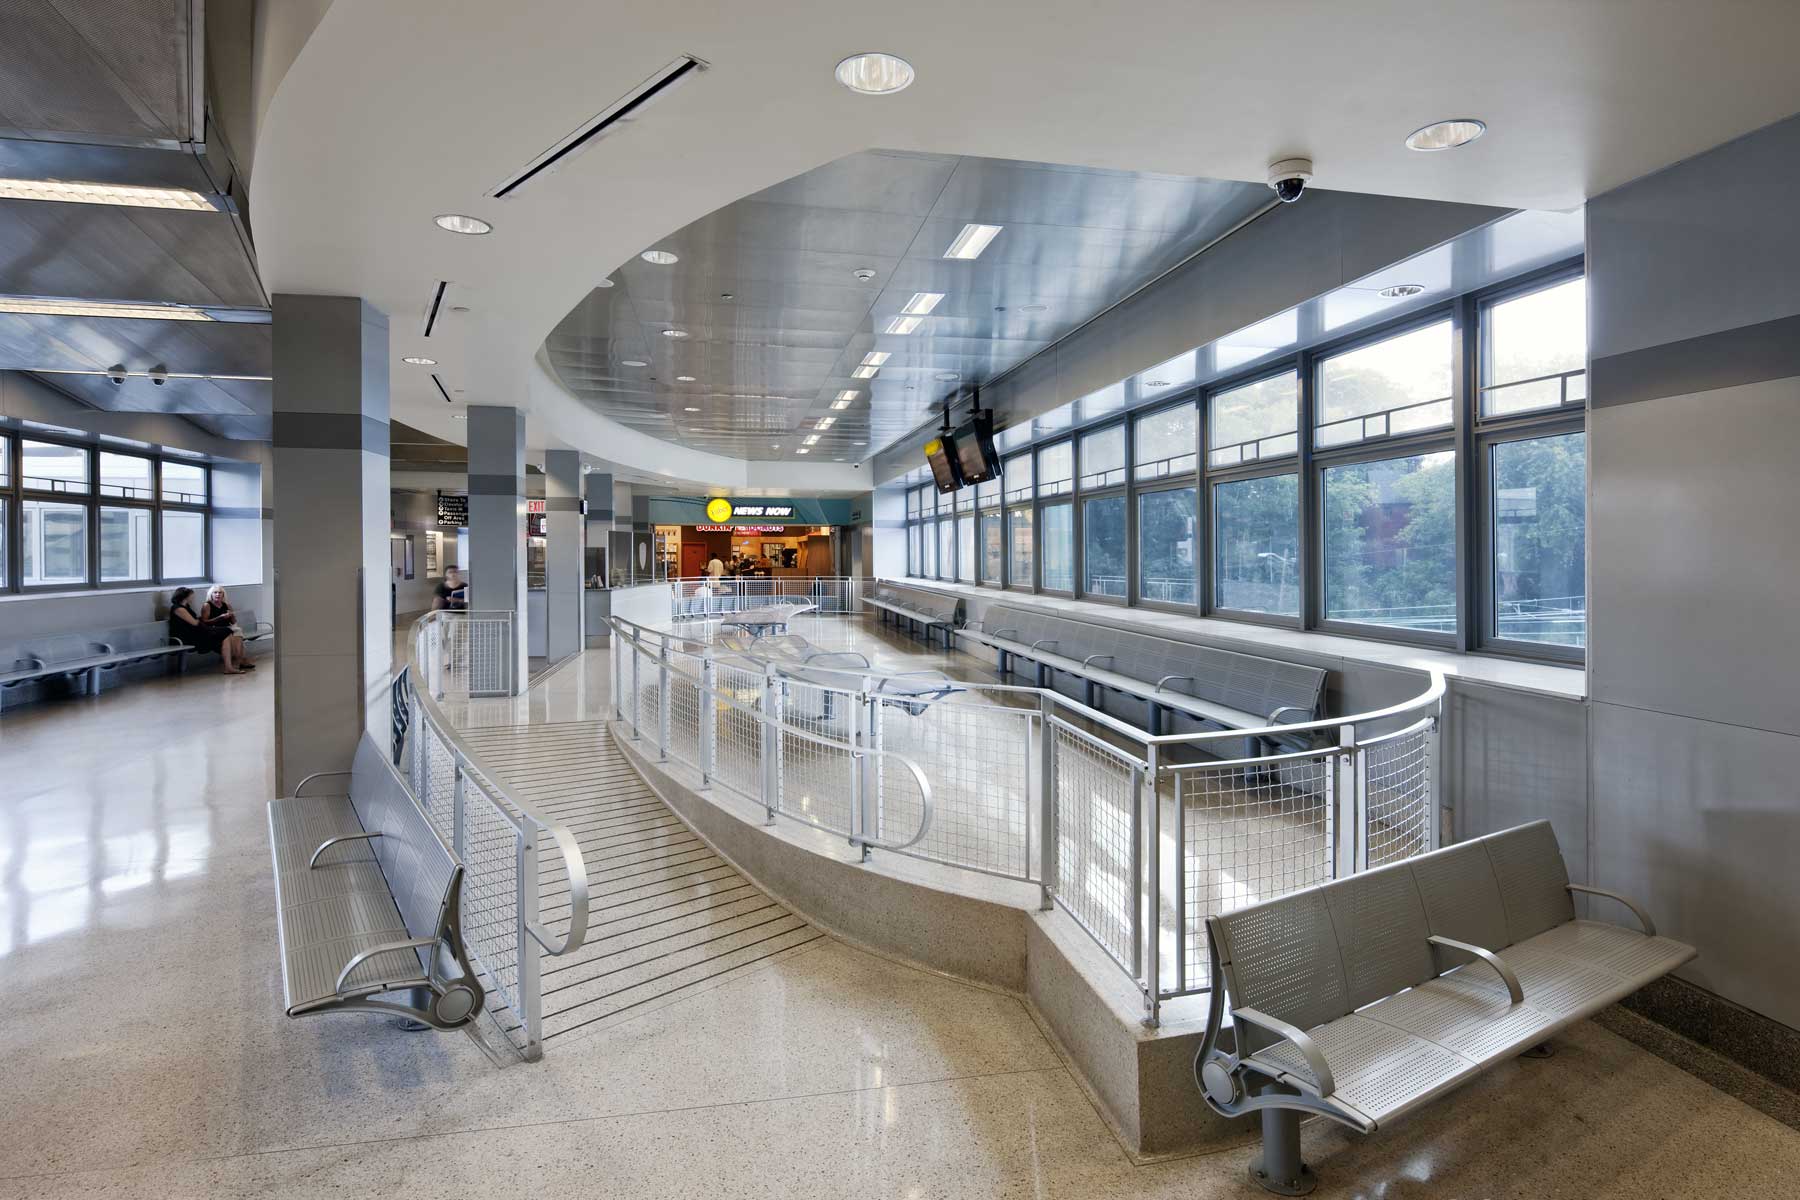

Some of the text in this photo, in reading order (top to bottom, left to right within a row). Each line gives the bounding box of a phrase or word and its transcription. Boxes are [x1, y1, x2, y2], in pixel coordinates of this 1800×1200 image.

[529, 501, 544, 512] EXIT
[734, 507, 763, 515] NEWS
[765, 507, 791, 515] NOW
